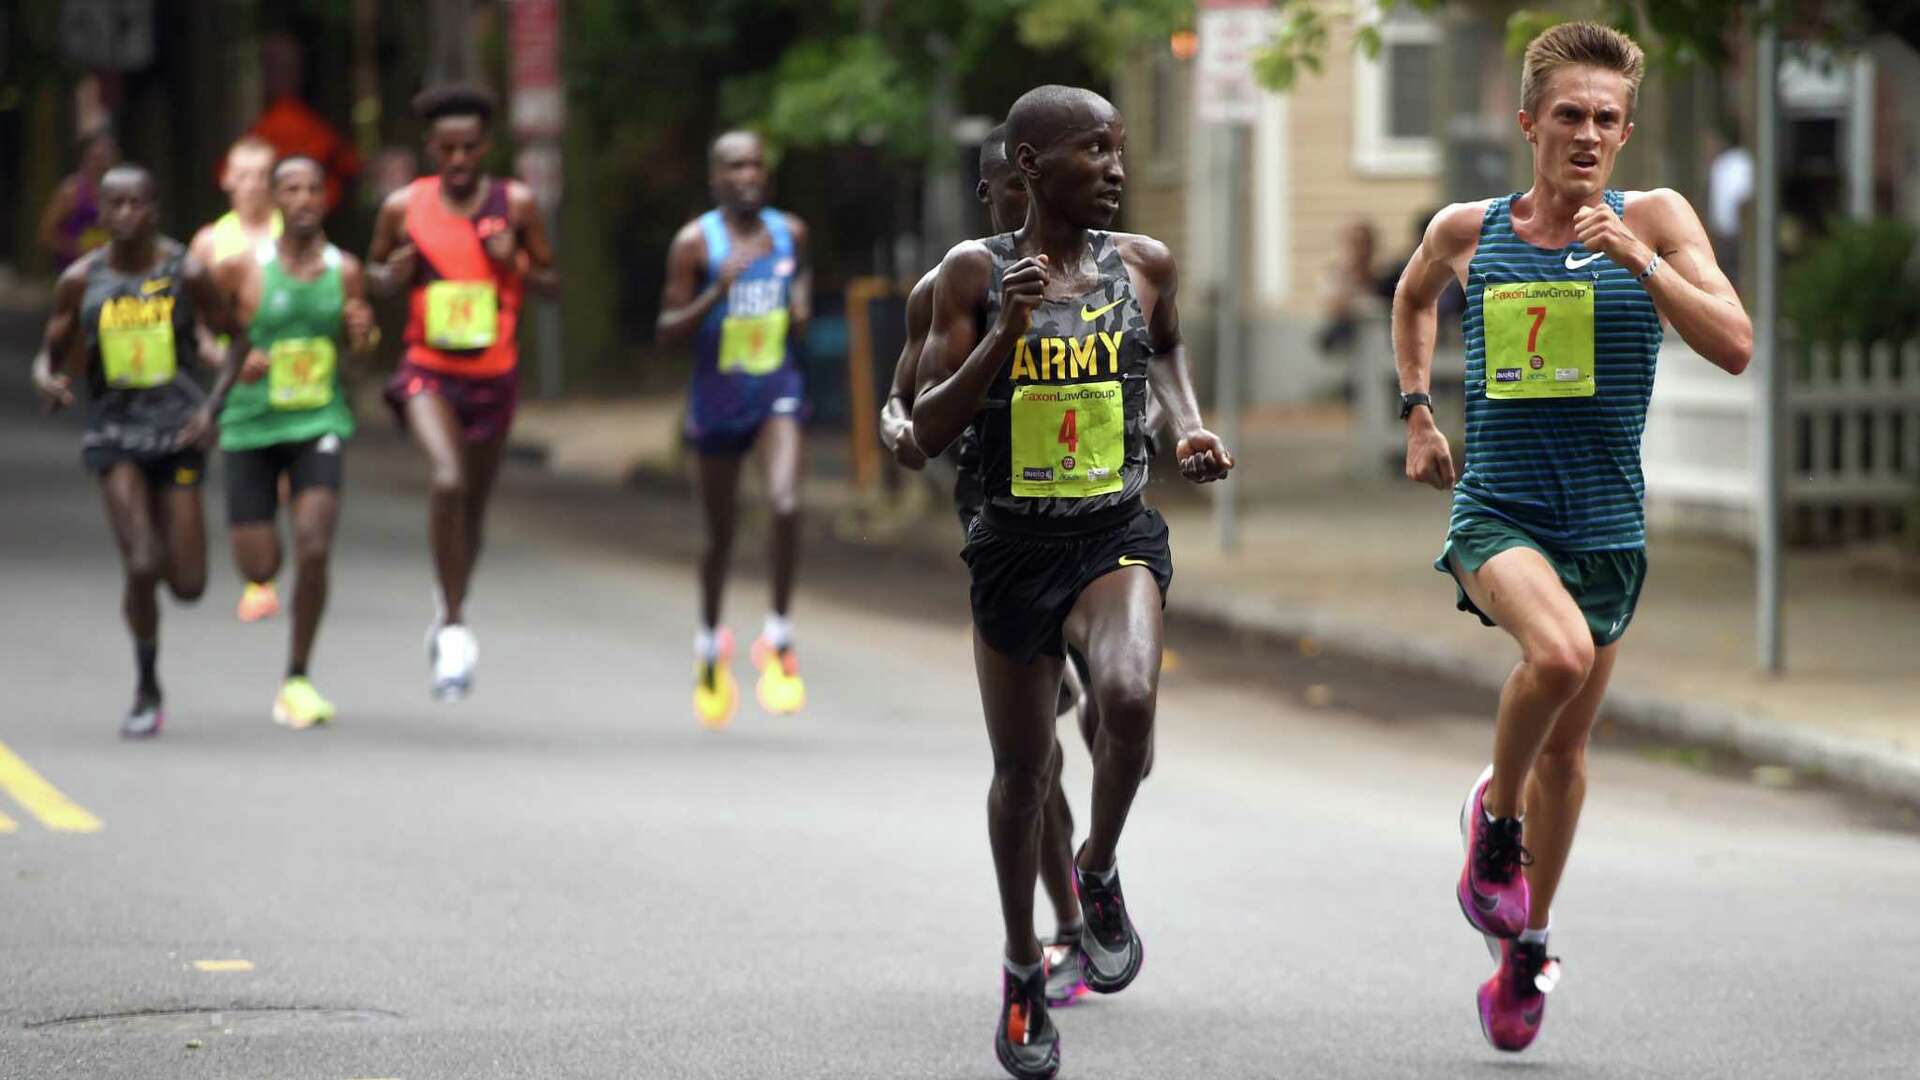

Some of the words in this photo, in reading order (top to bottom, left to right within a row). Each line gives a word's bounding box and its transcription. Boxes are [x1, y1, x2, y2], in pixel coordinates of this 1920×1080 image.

[100, 295, 175, 329] ARMY
[1493, 286, 1586, 300] FaxonLawGroup
[1526, 306, 1546, 353] 7
[1009, 331, 1122, 380] ARMY
[1022, 388, 1116, 402] FaxonLawGroup
[1057, 408, 1079, 453] 4
